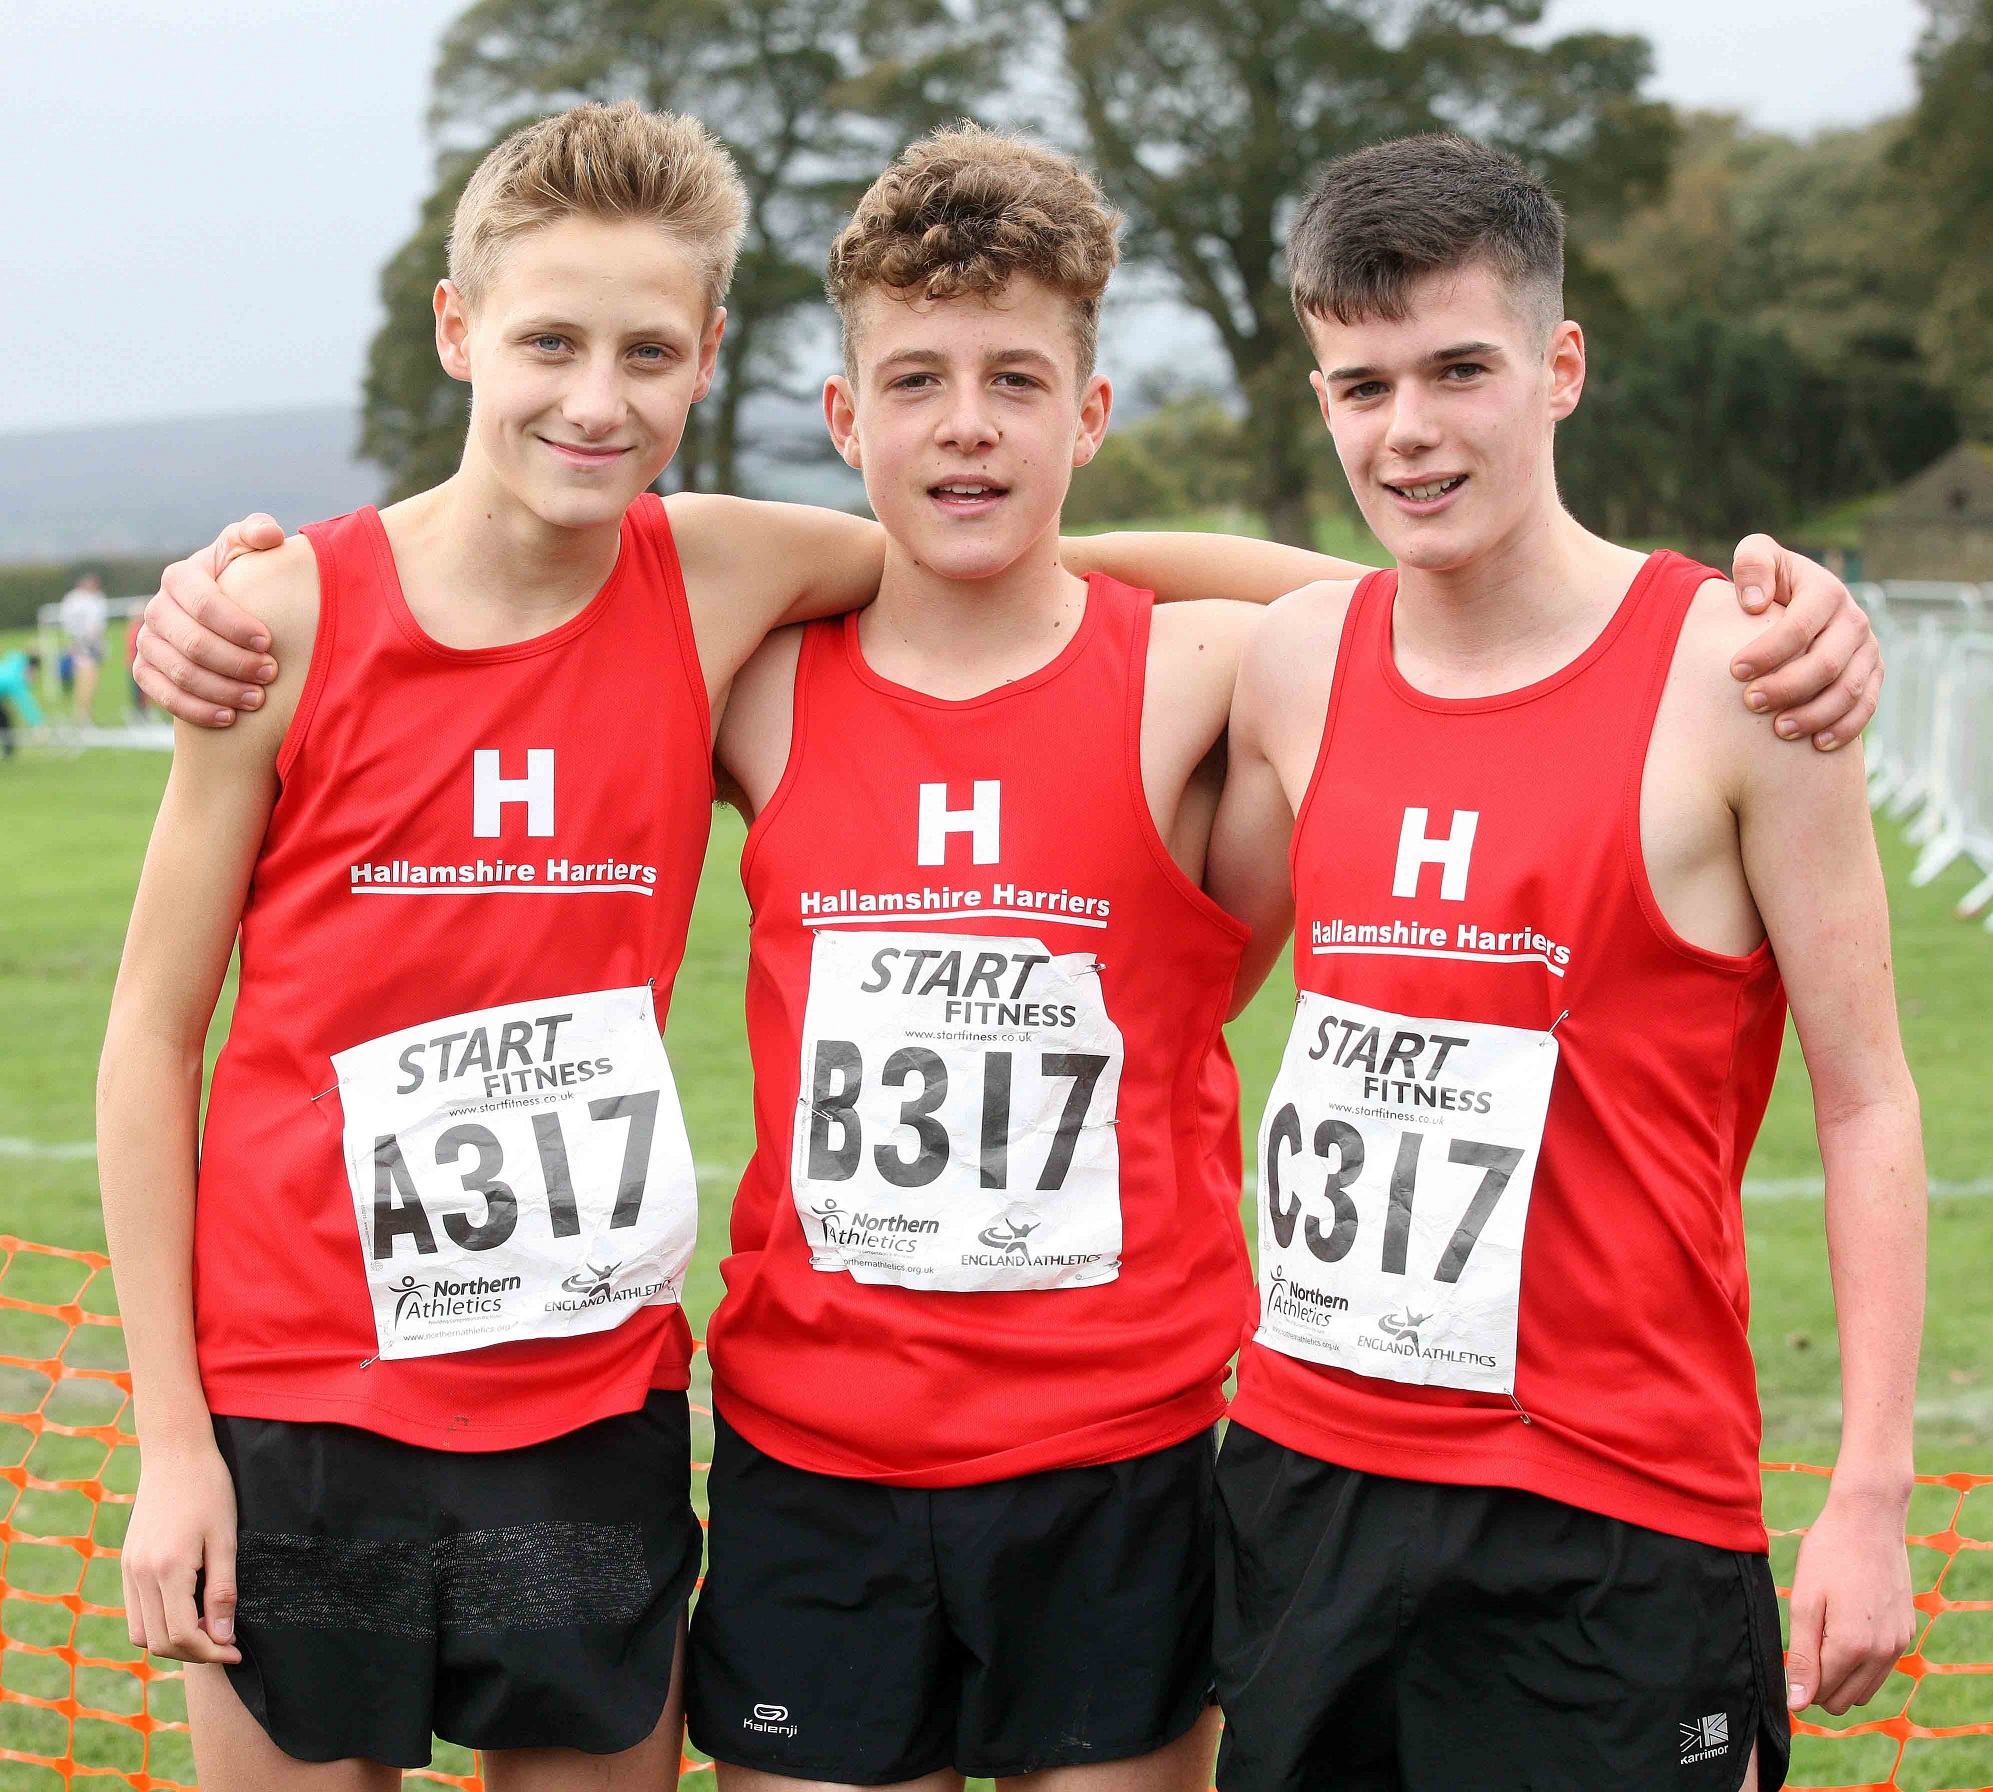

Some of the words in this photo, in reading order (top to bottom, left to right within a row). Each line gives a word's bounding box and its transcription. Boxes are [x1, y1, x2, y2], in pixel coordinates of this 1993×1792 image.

[473, 748, 555, 838] H
[917, 779, 1001, 866] H
[1392, 806, 1480, 902] H
[351, 859, 536, 884] Hallamshire
[546, 858, 657, 884] Harriers
[801, 887, 982, 915] Hallamshire
[993, 884, 1110, 917] Harriers
[1312, 919, 1447, 947] Hallamshire
[1457, 924, 1571, 965] Harriers
[860, 947, 1051, 1000] START
[945, 1000, 1077, 1028] FITNESS
[904, 1029, 1032, 1043] www.startfitness.co.uk
[1308, 1015, 1470, 1082] START
[397, 1013, 573, 1095] START
[483, 1057, 614, 1098] FITNESS
[449, 1090, 575, 1117] www.startfitness.co.uk
[1364, 1076, 1493, 1115] FITNESS
[807, 1039, 1111, 1191] B317
[1328, 1100, 1445, 1126] www.startfitness.co.uk
[373, 1089, 661, 1260] A317
[1267, 1102, 1526, 1284] C317
[852, 1212, 940, 1234] Northern
[830, 1227, 918, 1253] Athletics
[843, 1257, 935, 1275] orthernathletics.org.uk
[961, 1254, 1025, 1267] ENGLAND
[1033, 1253, 1103, 1267] ATHLETICS
[433, 1275, 521, 1298] Northern
[545, 1296, 606, 1312] ENGLAND
[612, 1279, 671, 1302] ATHLETIC
[1290, 1281, 1349, 1311] Northern
[405, 1296, 502, 1320] Athletics
[1273, 1295, 1332, 1327] Athletics
[1357, 1335, 1414, 1357] ENGLAND
[1422, 1347, 1497, 1368] ATHLETICS
[743, 1718, 798, 1738] Kalenji
